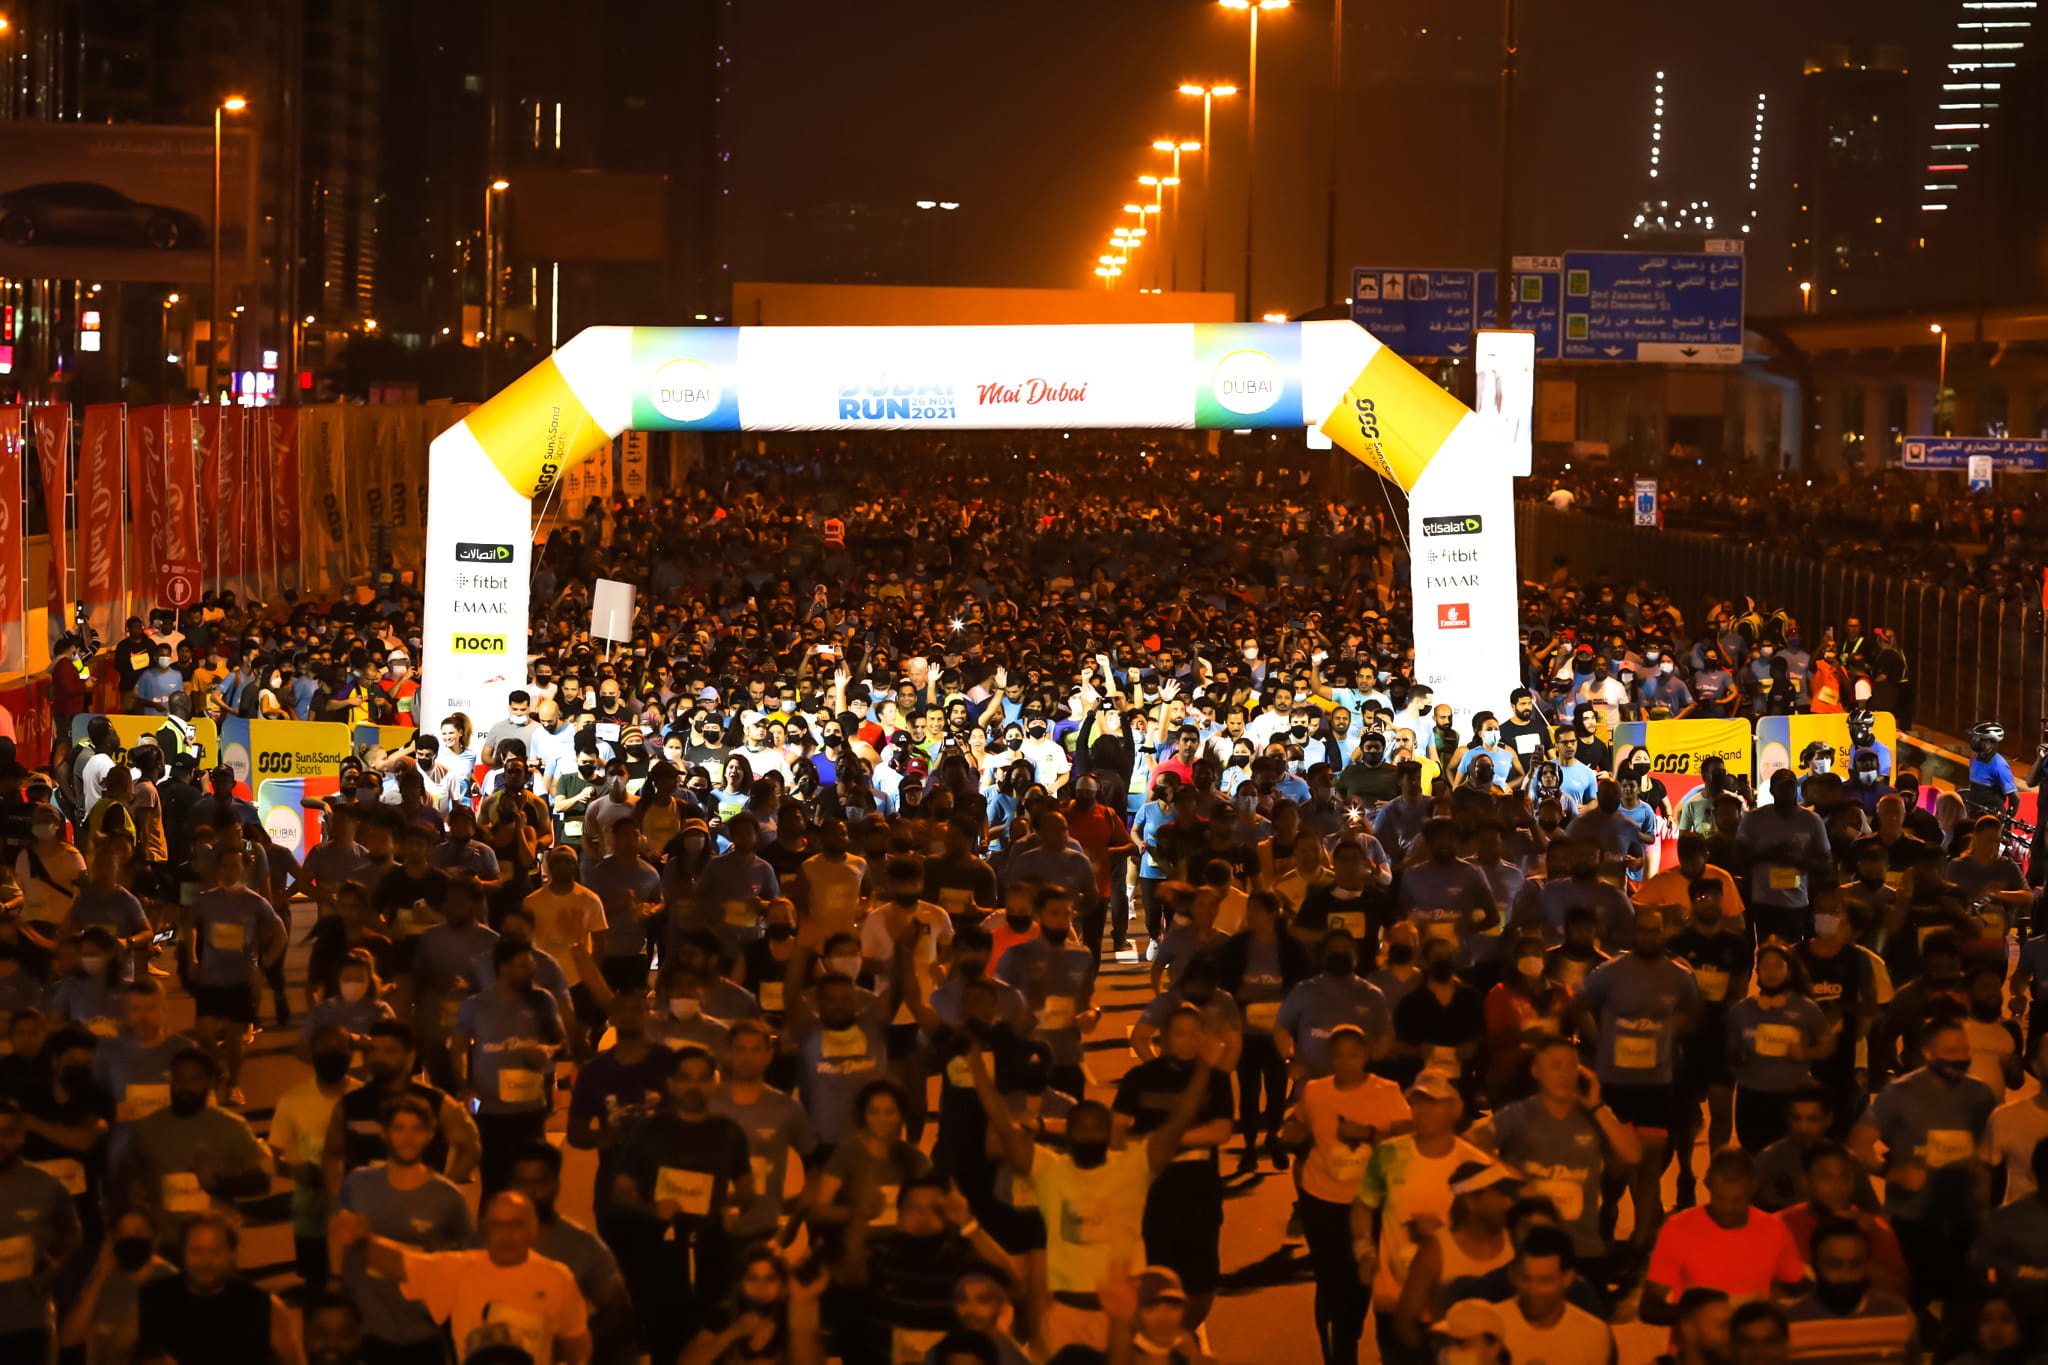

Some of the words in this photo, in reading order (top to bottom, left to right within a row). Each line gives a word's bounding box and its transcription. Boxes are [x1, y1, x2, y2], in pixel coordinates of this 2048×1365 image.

[1531, 258, 1558, 269] 54A
[1709, 260, 1739, 274] شارع
[1709, 277, 1738, 291] شارع
[1708, 317, 1738, 330] شارع
[977, 381, 1023, 406] Mai
[1025, 377, 1089, 405] Dubai
[1223, 380, 1272, 394] DUBAI
[660, 389, 710, 403] DUBAI
[911, 397, 926, 406] 26
[929, 397, 955, 406] NOV
[839, 398, 911, 420] RUN
[911, 407, 956, 420] 2021
[544, 406, 561, 460] Sun&Sand
[554, 431, 567, 461] Sports
[1638, 515, 1653, 524] 52
[460, 549, 496, 560] اتصالات
[1442, 548, 1478, 563] fitbit
[473, 575, 508, 589] fitbit
[1427, 574, 1480, 588] EMAAR
[454, 600, 508, 614] EMAAR
[455, 636, 504, 650] noon
[295, 751, 341, 764] Sun&Sand
[296, 764, 322, 776] Sports
[1812, 980, 1843, 993] eko
